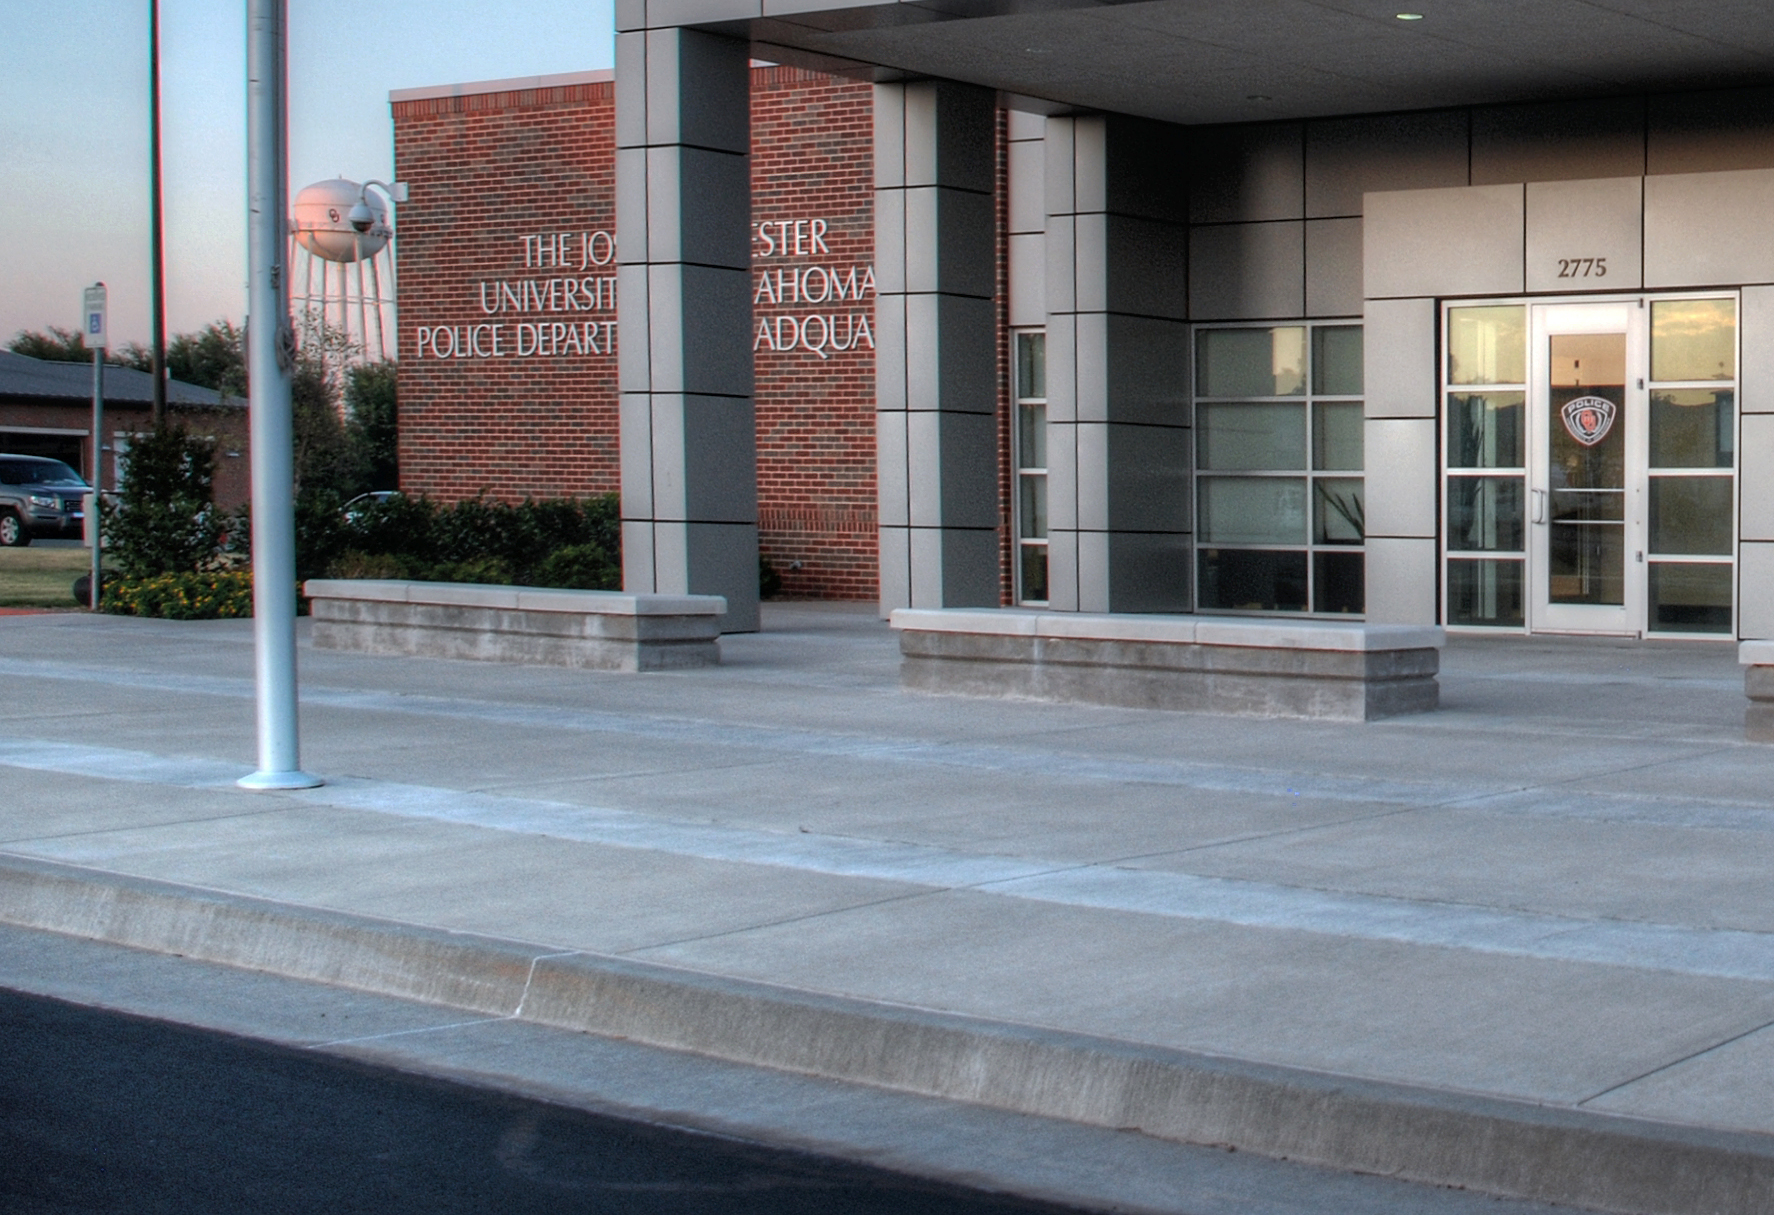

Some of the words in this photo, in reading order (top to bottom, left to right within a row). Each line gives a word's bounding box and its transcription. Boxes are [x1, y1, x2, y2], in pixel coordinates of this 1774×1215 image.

[519, 233, 572, 267] THE
[579, 231, 617, 271] JO
[1557, 258, 1607, 278] 2775
[480, 277, 618, 314] UNIVERSIT
[753, 265, 876, 304] AHOMA
[417, 324, 505, 358] POLICE
[517, 321, 618, 356] DEPART
[753, 314, 876, 360] ADQUA
[1567, 399, 1610, 413] POLICE
